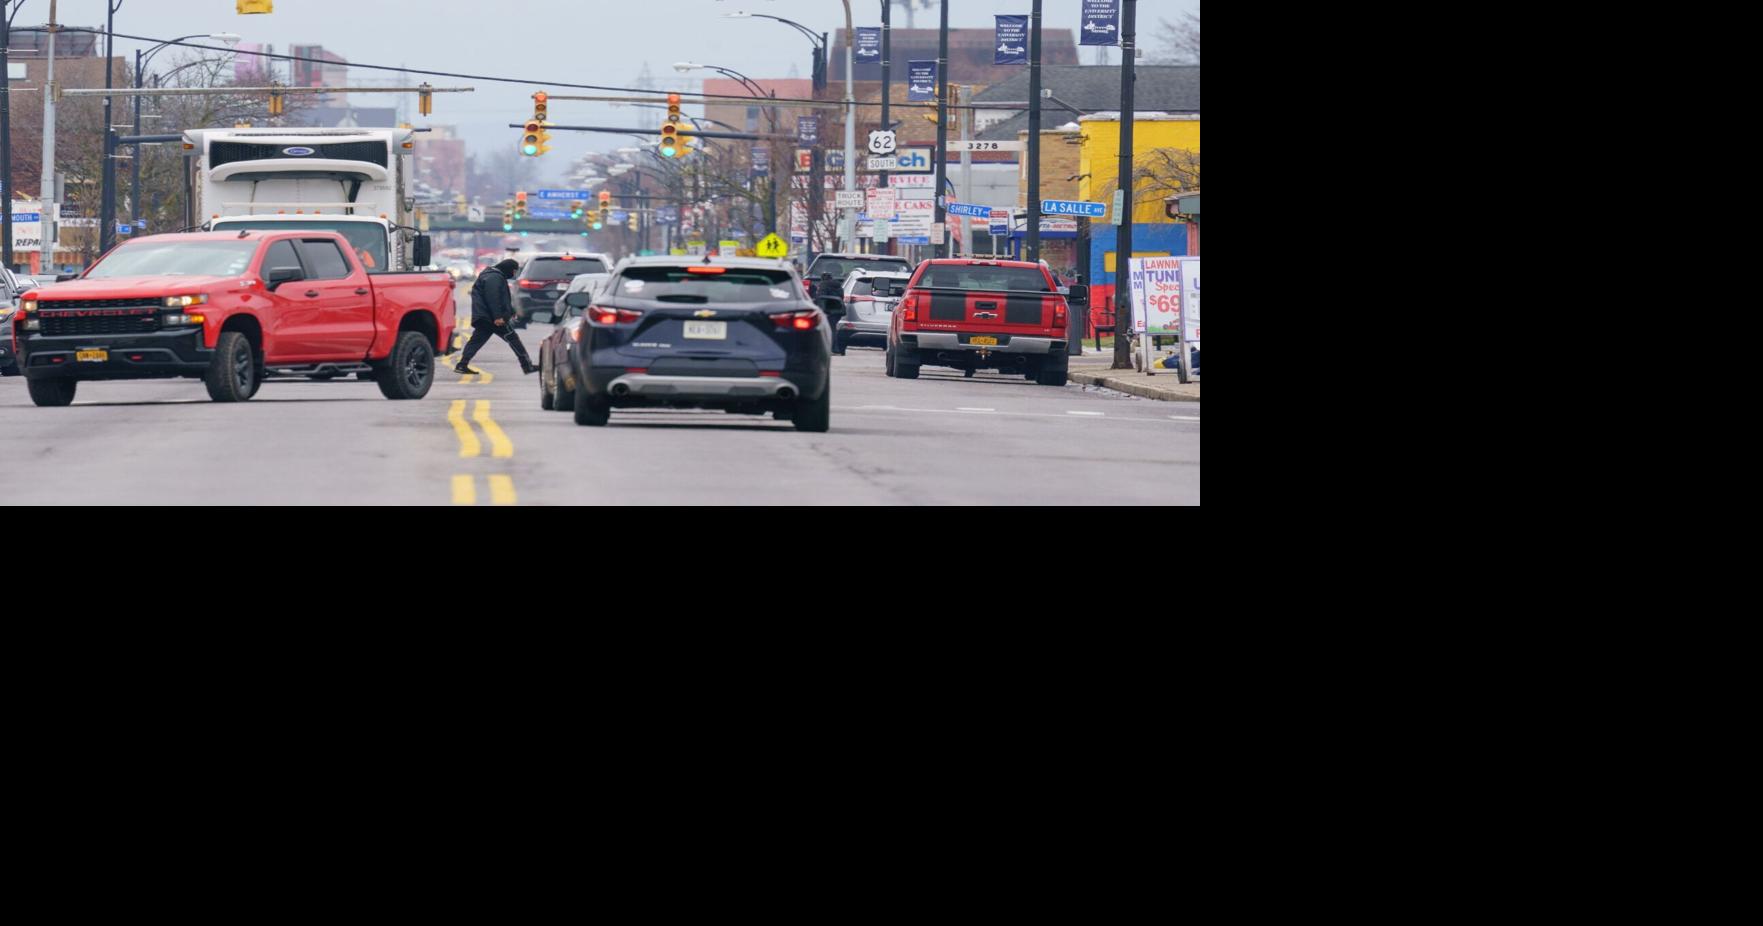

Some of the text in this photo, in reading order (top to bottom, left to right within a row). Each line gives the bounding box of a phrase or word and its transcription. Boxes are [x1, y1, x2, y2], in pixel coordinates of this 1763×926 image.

[873, 136, 892, 149] 62
[870, 160, 894, 168] SOUTH
[950, 204, 983, 216] SHIRLEY
[1044, 202, 1057, 212] LA
[1060, 202, 1092, 214] SALLE
[40, 308, 157, 317] CHEVROLET
